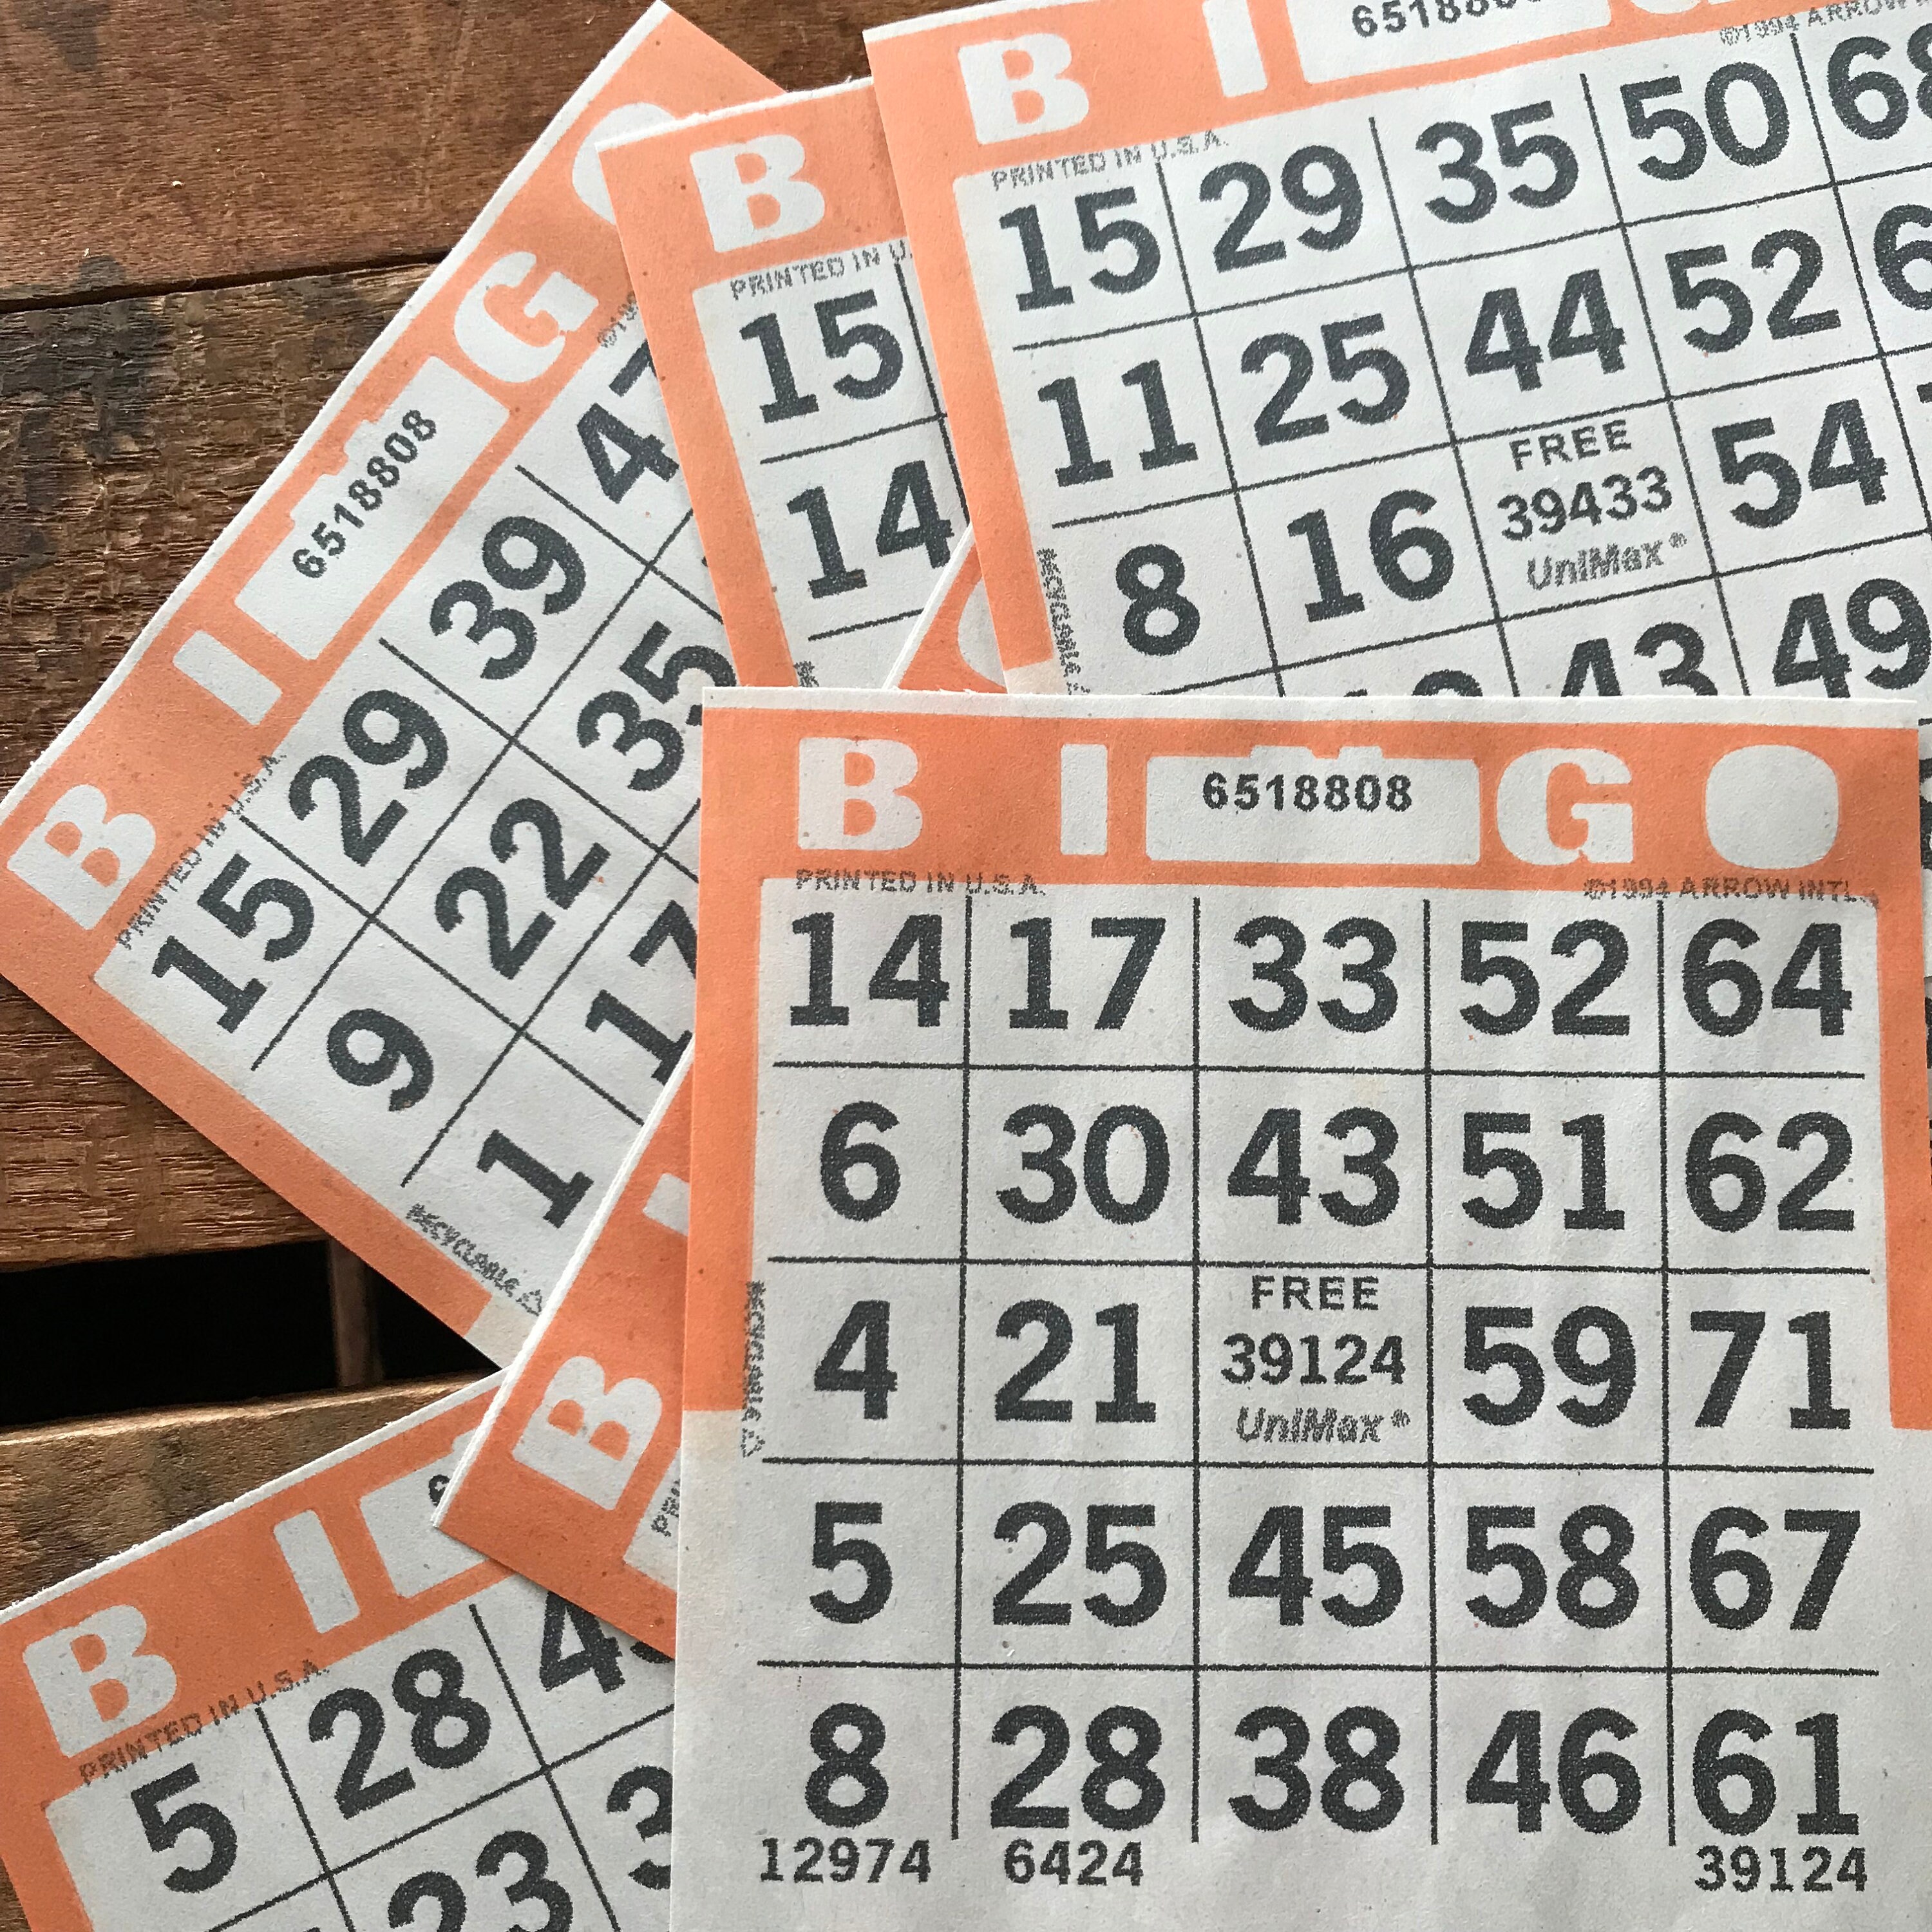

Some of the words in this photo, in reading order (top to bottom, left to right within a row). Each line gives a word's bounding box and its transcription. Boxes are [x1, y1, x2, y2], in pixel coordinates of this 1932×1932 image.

[1353, 0, 1540, 37] 65188
[958, 33, 1090, 144] B
[689, 134, 825, 252] B
[992, 152, 1106, 191] PRINTED
[1115, 145, 1142, 168] IN
[1151, 129, 1229, 160] U.S.A.
[999, 187, 1161, 311] 15
[1200, 146, 1363, 272] 29
[1416, 101, 1578, 223] 35
[1620, 62, 1790, 180] 50
[730, 256, 845, 301] PRINTED
[852, 246, 880, 273] IN
[739, 290, 902, 423] 15
[1038, 360, 1198, 487] 11
[1241, 314, 1410, 446] 25
[1465, 269, 1625, 391] 44
[1665, 229, 1841, 353] 52
[293, 410, 436, 578] 6518808
[1498, 466, 1672, 541] 39433
[1511, 420, 1631, 471] FREE
[6, 784, 156, 931] B
[454, 251, 600, 383] G
[787, 460, 954, 599] 14
[1115, 544, 1200, 656] 8
[1287, 490, 1454, 622] 16
[1712, 399, 1888, 528] 54
[1772, 578, 1932, 698] 49
[151, 853, 314, 1033] 15
[289, 690, 448, 866] 29
[430, 516, 585, 679] 39
[799, 737, 923, 850] B
[1497, 747, 1633, 865] G
[1203, 772, 1412, 812] 6518808
[115, 846, 202, 951] PRINTED
[196, 817, 227, 848] IN
[327, 1009, 433, 1112] 9
[435, 798, 611, 980] 22
[577, 621, 736, 791] 35
[797, 869, 916, 891] PRINTED
[927, 870, 955, 893] IN
[1679, 876, 1790, 900] ARROW
[790, 912, 949, 1027] 14
[1009, 917, 1166, 1030] 17
[1229, 916, 1398, 1033] 33
[1460, 919, 1629, 1036] 52
[1682, 919, 1852, 1037] 64
[477, 1130, 594, 1228] 1
[820, 1101, 900, 1222] 6
[996, 1104, 1170, 1226] 30
[1227, 1107, 1399, 1227] 43
[1462, 1112, 1625, 1230] 51
[1685, 1112, 1855, 1233] 62
[1251, 1275, 1378, 1311] FREE
[814, 1300, 897, 1420] 4
[994, 1299, 1156, 1423] 21
[1463, 1305, 1636, 1428] 59
[1690, 1311, 1850, 1430] 71
[1221, 1332, 1406, 1386] 39124
[513, 1356, 662, 1510] B
[810, 1501, 893, 1624] 5
[992, 1501, 1166, 1627] 25
[1228, 1504, 1403, 1627] 45
[1466, 1504, 1639, 1629] 58
[1689, 1506, 1861, 1631] 67
[22, 1605, 177, 1757] B
[79, 1712, 202, 1786] PRINTED
[208, 1694, 240, 1727] IN
[131, 1763, 238, 1893] 5
[306, 1648, 491, 1820] 28
[539, 1591, 675, 1694] 4
[805, 1703, 889, 1829] 8
[990, 1705, 1165, 1832] 28
[1228, 1706, 1404, 1833] 38
[1466, 1707, 1642, 1835] 46
[1692, 1709, 1859, 1836] 61
[761, 1837, 931, 1883] 12974
[1004, 1839, 1143, 1886] 6424
[1695, 1845, 1867, 1892] 39124
